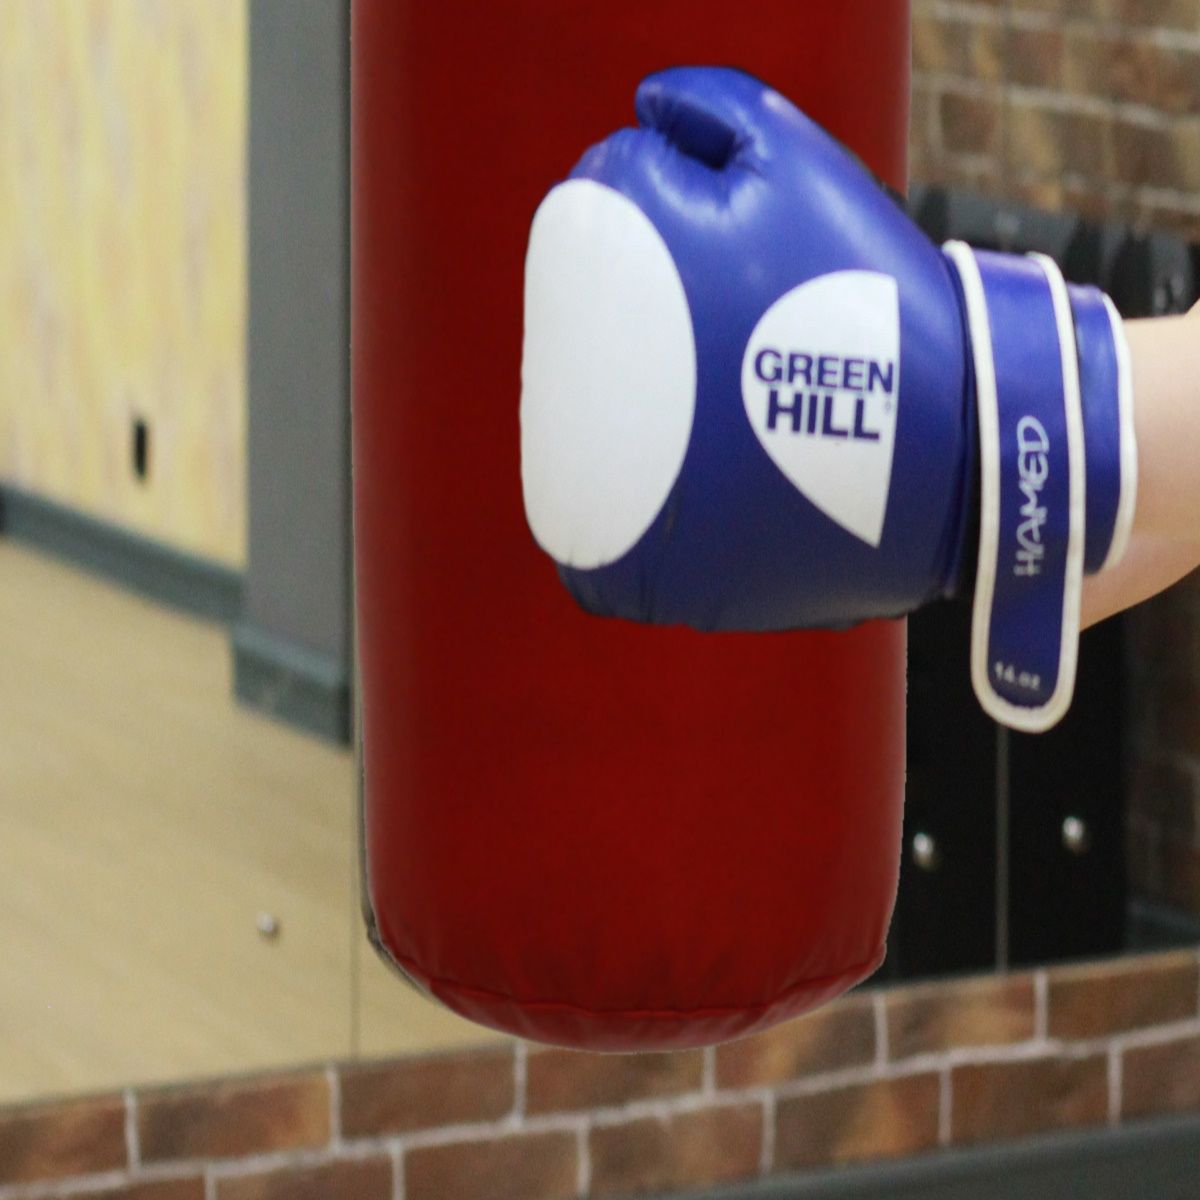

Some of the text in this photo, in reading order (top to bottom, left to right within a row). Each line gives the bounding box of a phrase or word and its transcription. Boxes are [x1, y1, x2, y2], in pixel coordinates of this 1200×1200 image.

[754, 349, 894, 392] GREEN
[767, 390, 880, 440] HILL
[1013, 415, 1050, 576] HAMED
